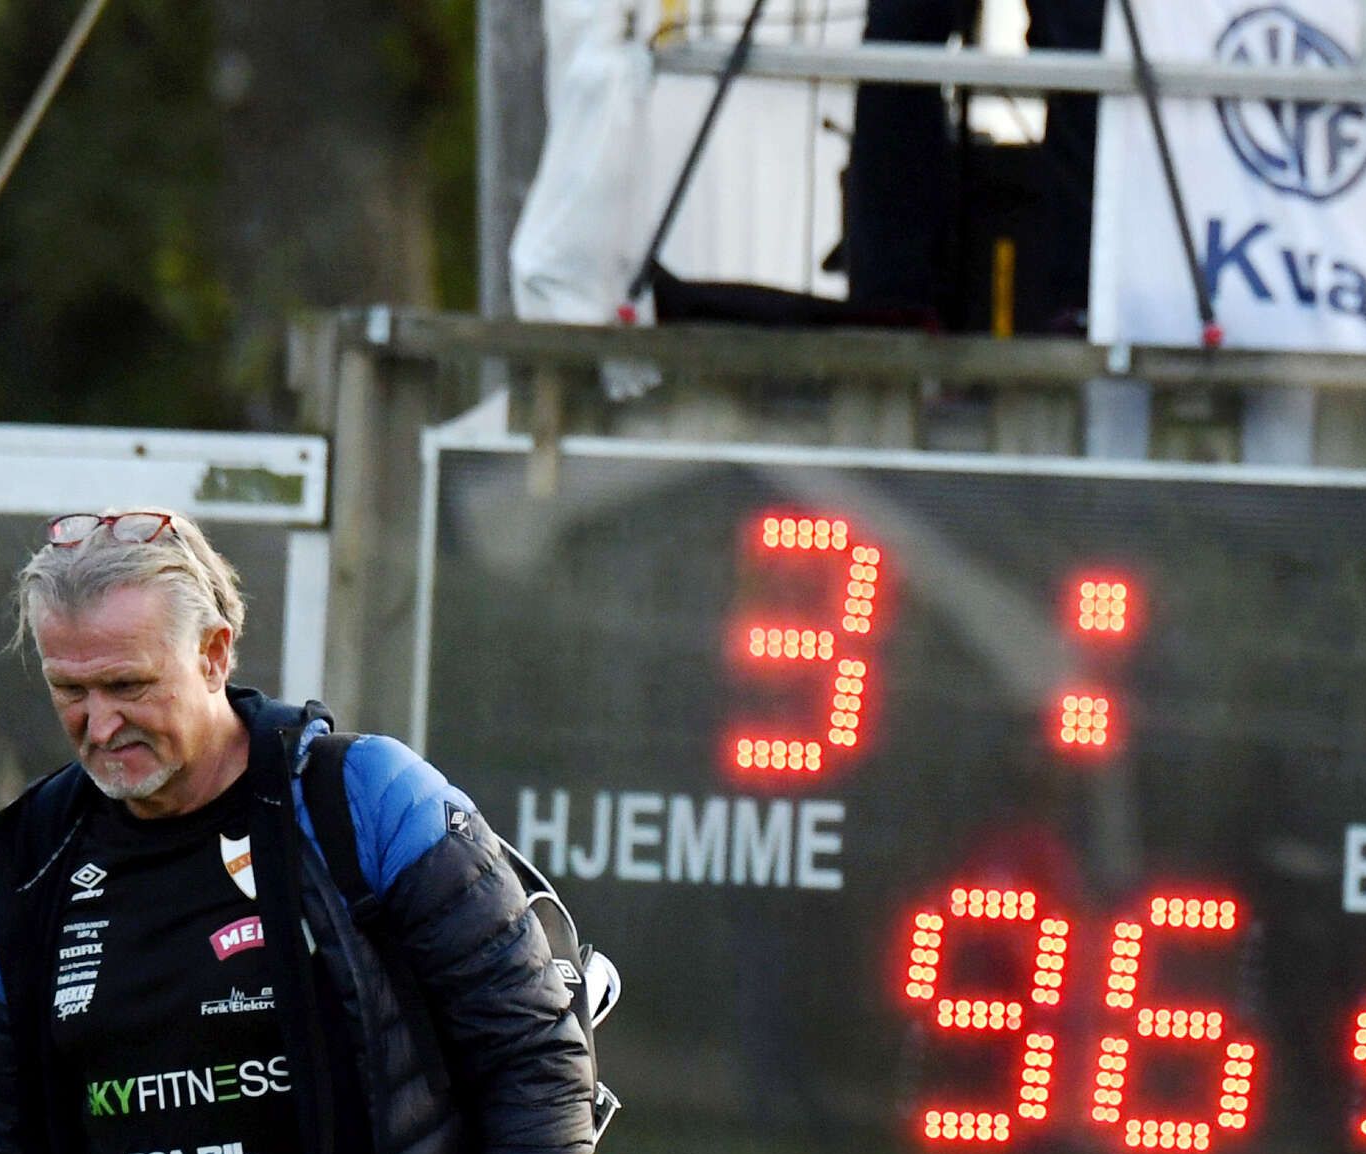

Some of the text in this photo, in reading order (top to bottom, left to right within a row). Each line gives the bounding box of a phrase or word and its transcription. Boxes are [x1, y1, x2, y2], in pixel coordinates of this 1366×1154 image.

[736, 516, 882, 772] 3
[518, 788, 846, 890] HJEMME
[88, 1055, 292, 1117] KYFITNESS
[905, 887, 1256, 1151] 96
